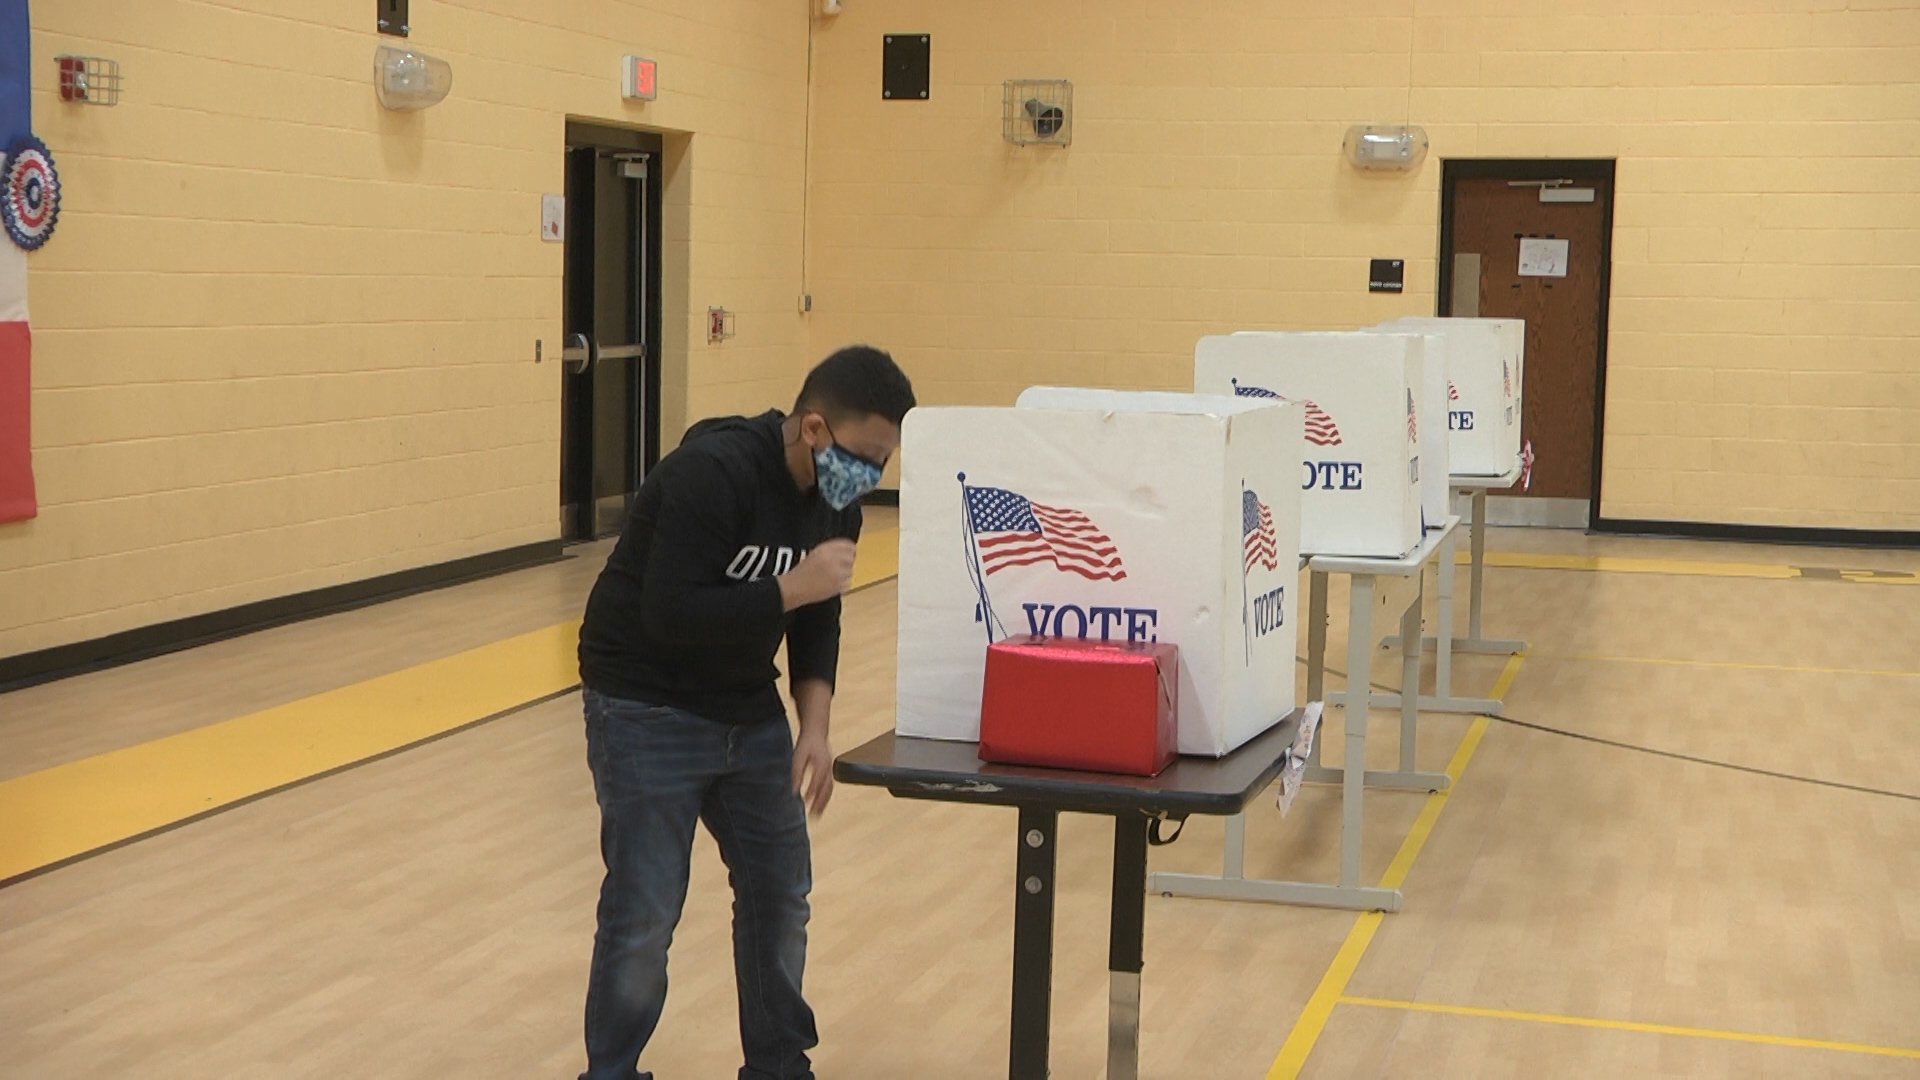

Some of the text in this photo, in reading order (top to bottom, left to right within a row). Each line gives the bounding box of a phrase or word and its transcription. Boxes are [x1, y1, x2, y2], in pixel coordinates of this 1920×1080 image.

[1449, 411, 1474, 430] TE
[1302, 461, 1362, 490] OTE
[1022, 603, 1158, 643] VOTE
[1254, 585, 1284, 637] VOTE
